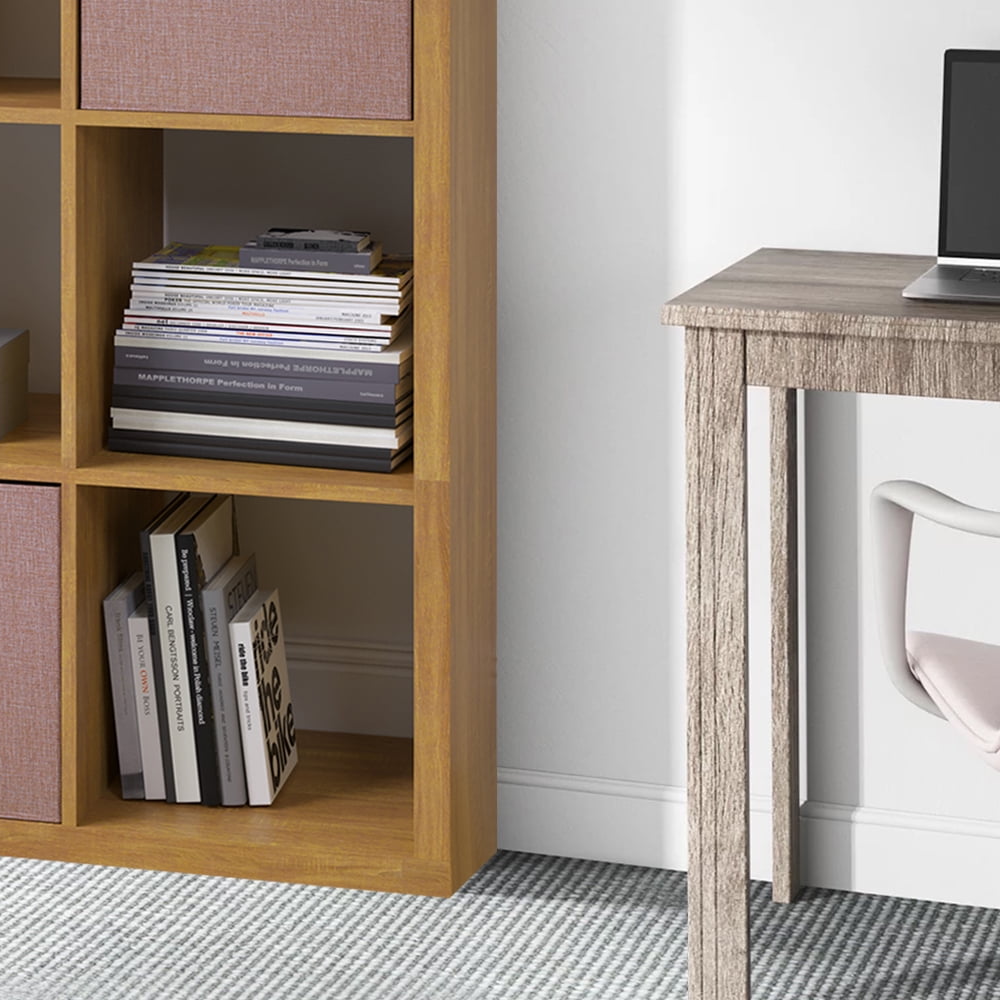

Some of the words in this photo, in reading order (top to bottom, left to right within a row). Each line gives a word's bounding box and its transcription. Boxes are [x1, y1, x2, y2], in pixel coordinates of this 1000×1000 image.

[204, 358, 228, 367] Form
[242, 360, 291, 371] Perfection
[293, 365, 373, 377] MAPPLETHORPE
[138, 372, 215, 386] MAPPLETHORPE
[216, 378, 265, 390] Perfection
[278, 382, 304, 392] Form
[181, 557, 192, 592] prepared
[165, 605, 174, 628] CARL
[209, 607, 219, 638] STEVEN
[213, 640, 222, 668] MEISEL
[238, 643, 247, 658] ride
[252, 601, 279, 685] ride
[138, 645, 146, 668] YOUR
[167, 629, 181, 681] BENGTSSON
[239, 658, 248, 670] the
[140, 669, 149, 694] OWN
[241, 671, 249, 687] bike
[143, 696, 151, 716] BOSS
[173, 684, 185, 732] PORTRAITS
[257, 666, 282, 738] the
[267, 702, 297, 793] bike
